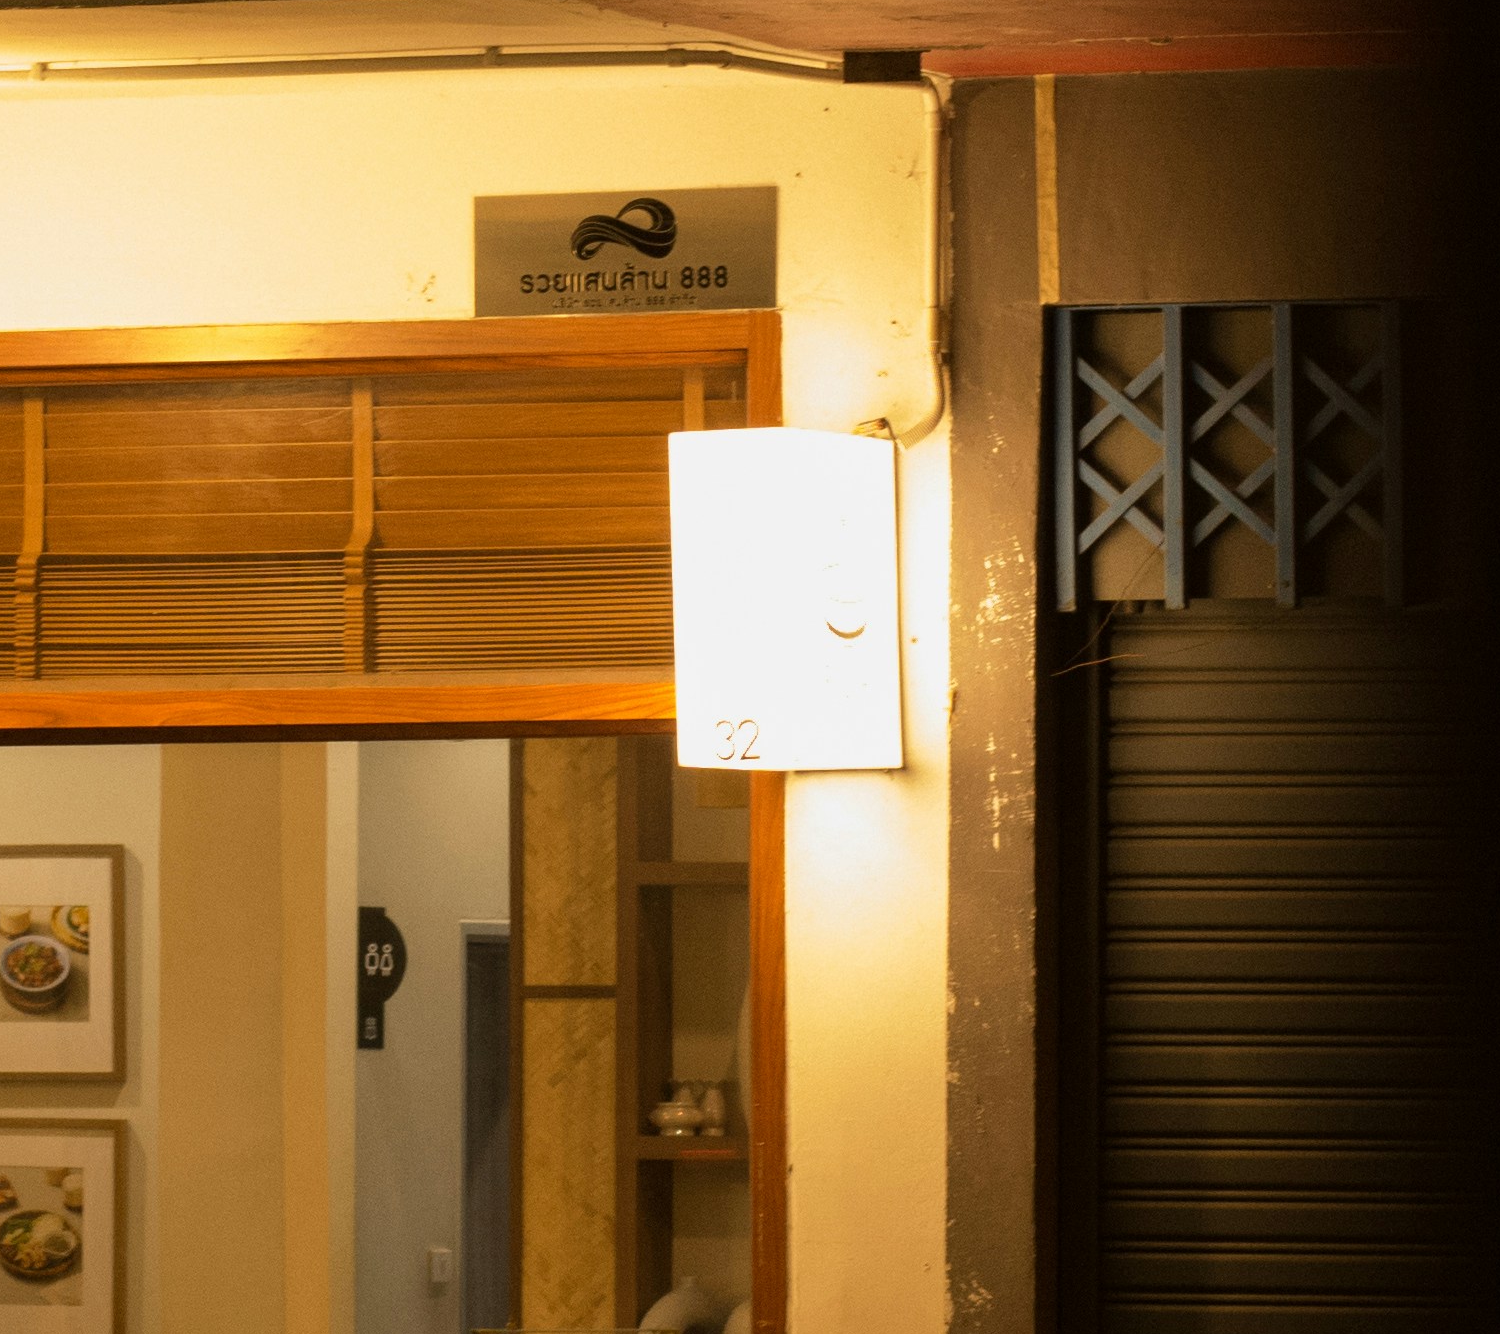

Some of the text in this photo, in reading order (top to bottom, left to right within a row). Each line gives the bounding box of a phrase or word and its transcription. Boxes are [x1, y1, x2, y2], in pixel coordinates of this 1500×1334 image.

[519, 262, 729, 294] รวยแสนล้าน 888
[714, 718, 761, 760] 32
